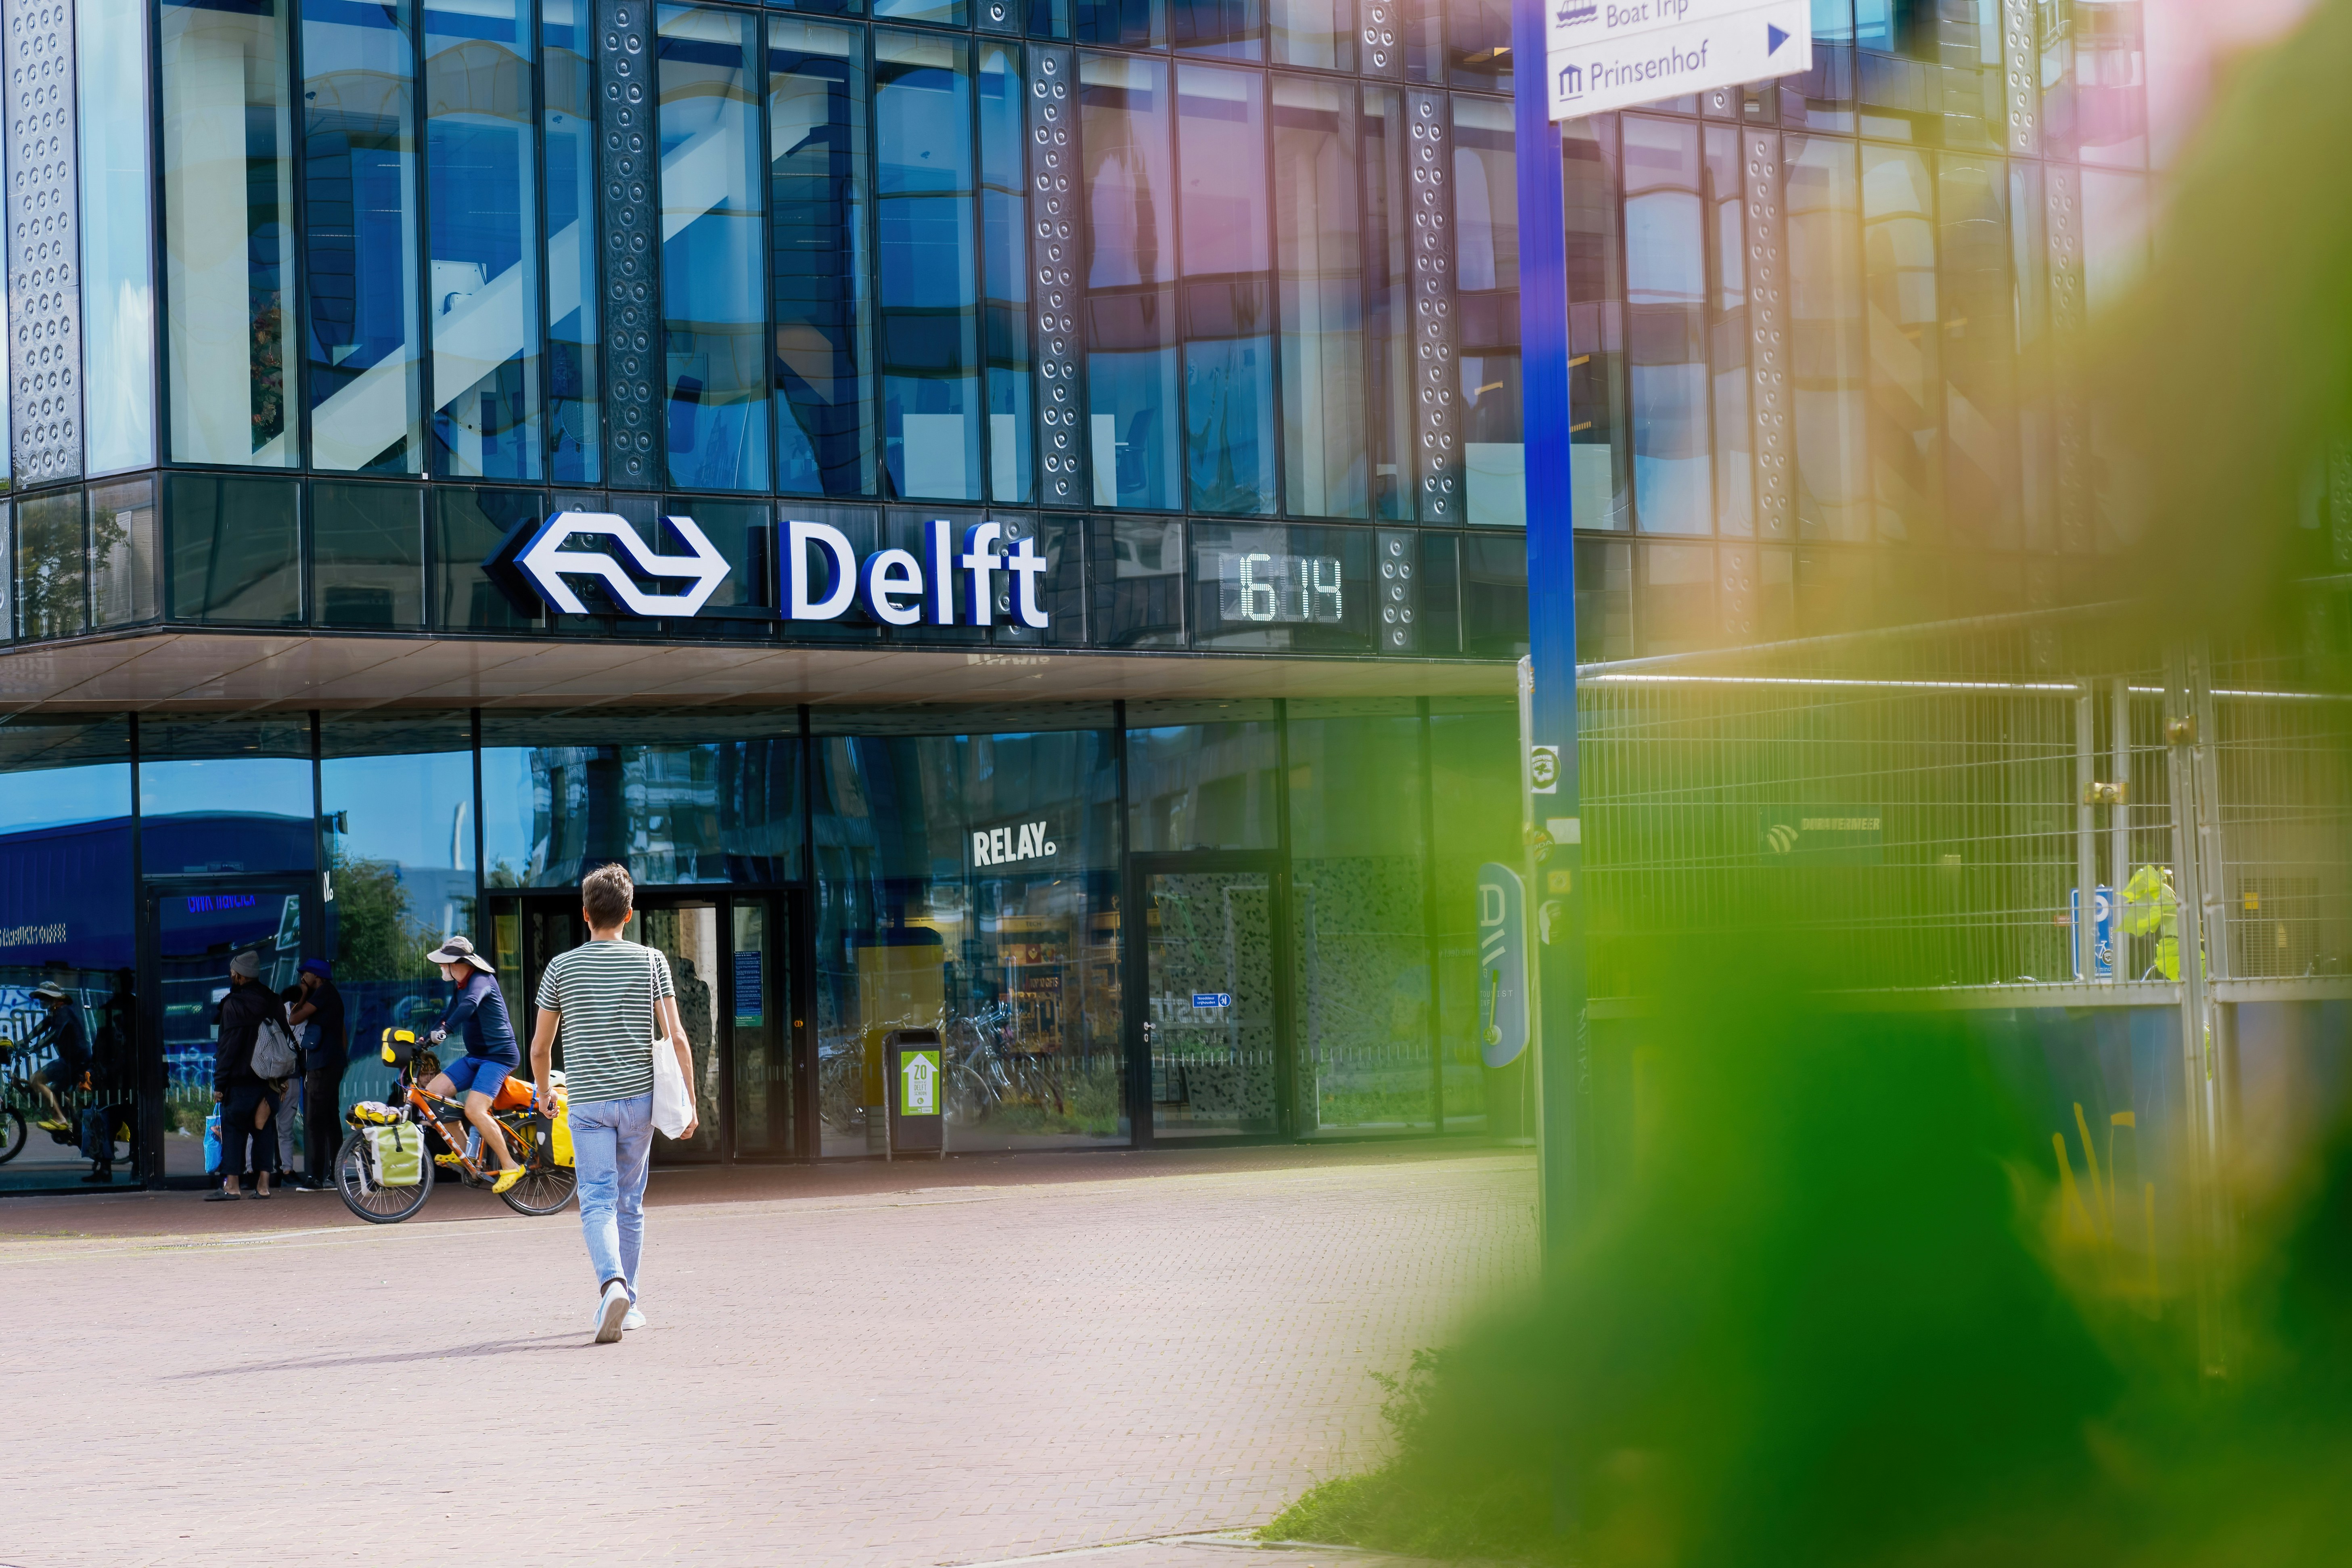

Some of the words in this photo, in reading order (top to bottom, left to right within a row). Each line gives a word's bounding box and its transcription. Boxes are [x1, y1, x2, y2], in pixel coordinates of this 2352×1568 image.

[1607, 4, 1649, 28] Boat
[1591, 39, 1709, 91] Prinsenhof
[778, 519, 1049, 628] Delft
[1480, 989, 1514, 998] TOUIST
